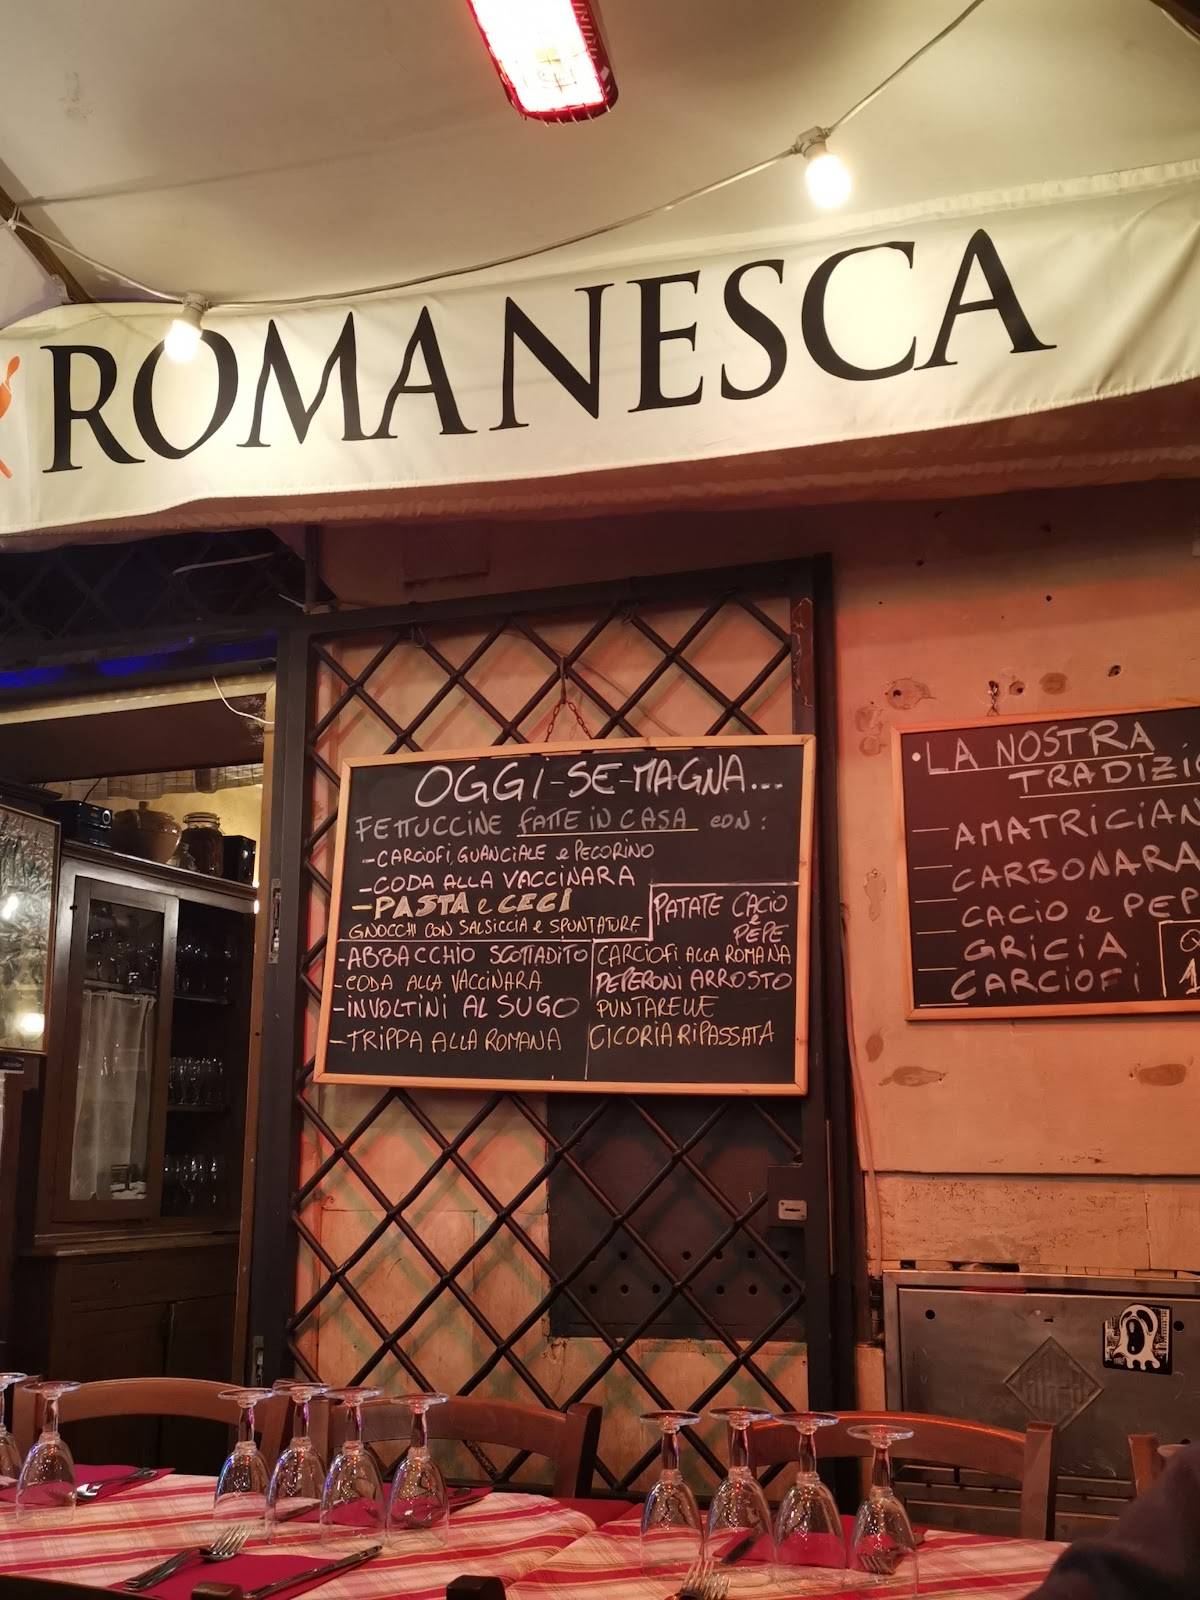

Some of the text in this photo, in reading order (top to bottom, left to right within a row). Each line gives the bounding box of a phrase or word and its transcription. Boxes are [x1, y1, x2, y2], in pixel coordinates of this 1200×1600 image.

[40, 229, 1057, 473] ROMANESCA
[926, 719, 1155, 772] LA NOSTRA
[1007, 742, 1200, 793] TRADIZI
[355, 810, 502, 841] FETTUCCINE
[620, 807, 688, 831] CASA
[457, 843, 546, 866] GUANCIALE
[574, 838, 654, 861] PECORINO
[443, 870, 494, 890] ALLA
[502, 864, 635, 889] VACCINARA
[653, 890, 788, 925] PATATE CACIO
[961, 899, 1069, 928] CACIO
[348, 922, 417, 940] GNOCCHI
[459, 914, 528, 935] SALSICCIA
[733, 920, 790, 945] PEPE
[597, 942, 678, 968] CARCIOFI
[725, 944, 791, 965] ROMANA
[963, 931, 1127, 962] GRICIA
[451, 969, 543, 993] VACCINARA
[595, 965, 793, 998] PEPERONI ARROSTO
[950, 962, 1140, 1000] CARCIOFI
[462, 994, 489, 1019] AL
[497, 994, 581, 1019] SUGO
[431, 1028, 478, 1053] ALLA
[485, 1026, 562, 1052] ROMANA
[589, 1020, 775, 1050] CICORIA RIPASSATA
